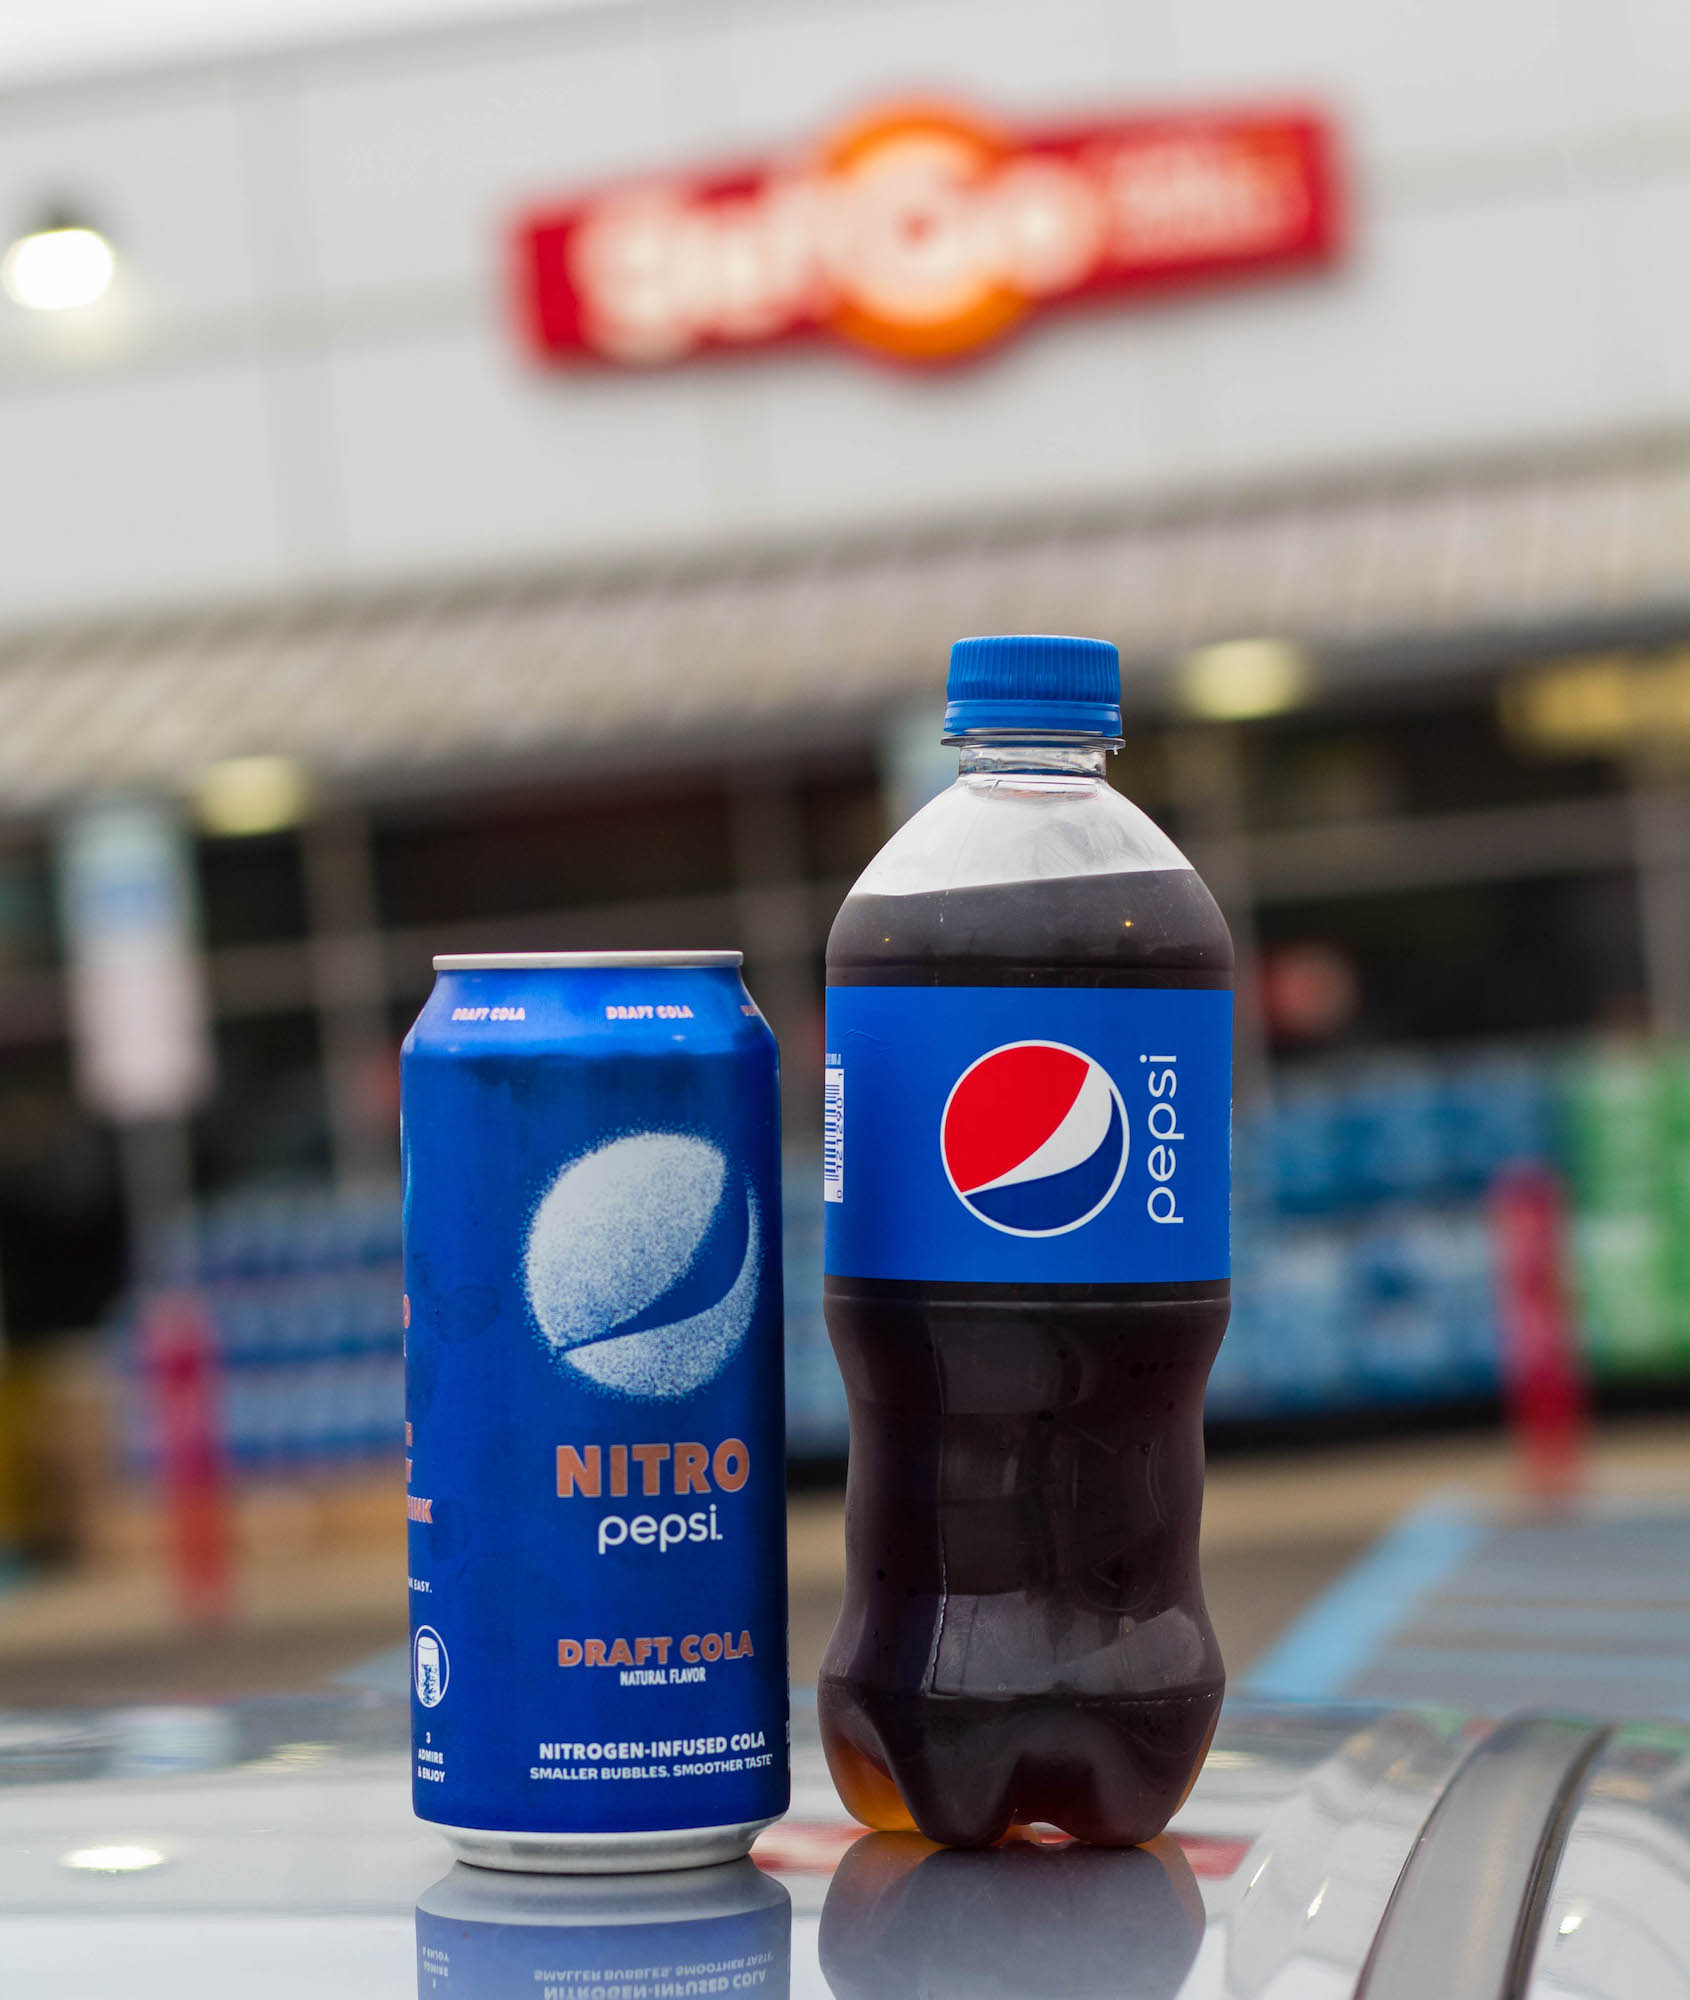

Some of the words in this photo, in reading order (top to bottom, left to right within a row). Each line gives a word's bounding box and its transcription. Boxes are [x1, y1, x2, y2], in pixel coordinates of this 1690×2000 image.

[451, 1007, 490, 1021] DRAFT
[489, 1007, 526, 1021] COLA
[605, 1005, 654, 1020] DRAFT
[655, 1004, 695, 1019] COLA
[1139, 1054, 1185, 1224] pepsi
[556, 1438, 750, 1498] NITRO
[558, 1636, 673, 1667] DRAFT
[679, 1630, 754, 1663] COLA
[619, 1669, 668, 1686] NATURAL
[669, 1667, 706, 1684] FLAVOR
[425, 1731, 432, 1744] 3
[539, 1736, 728, 1761] NITROGEN-INFUSED
[730, 1731, 766, 1752] COLA
[417, 1748, 444, 1765] ADMIRE
[422, 1768, 446, 1783] ENJOY
[530, 1767, 598, 1780] SMALLER
[673, 1759, 744, 1777] SMOOTHER
